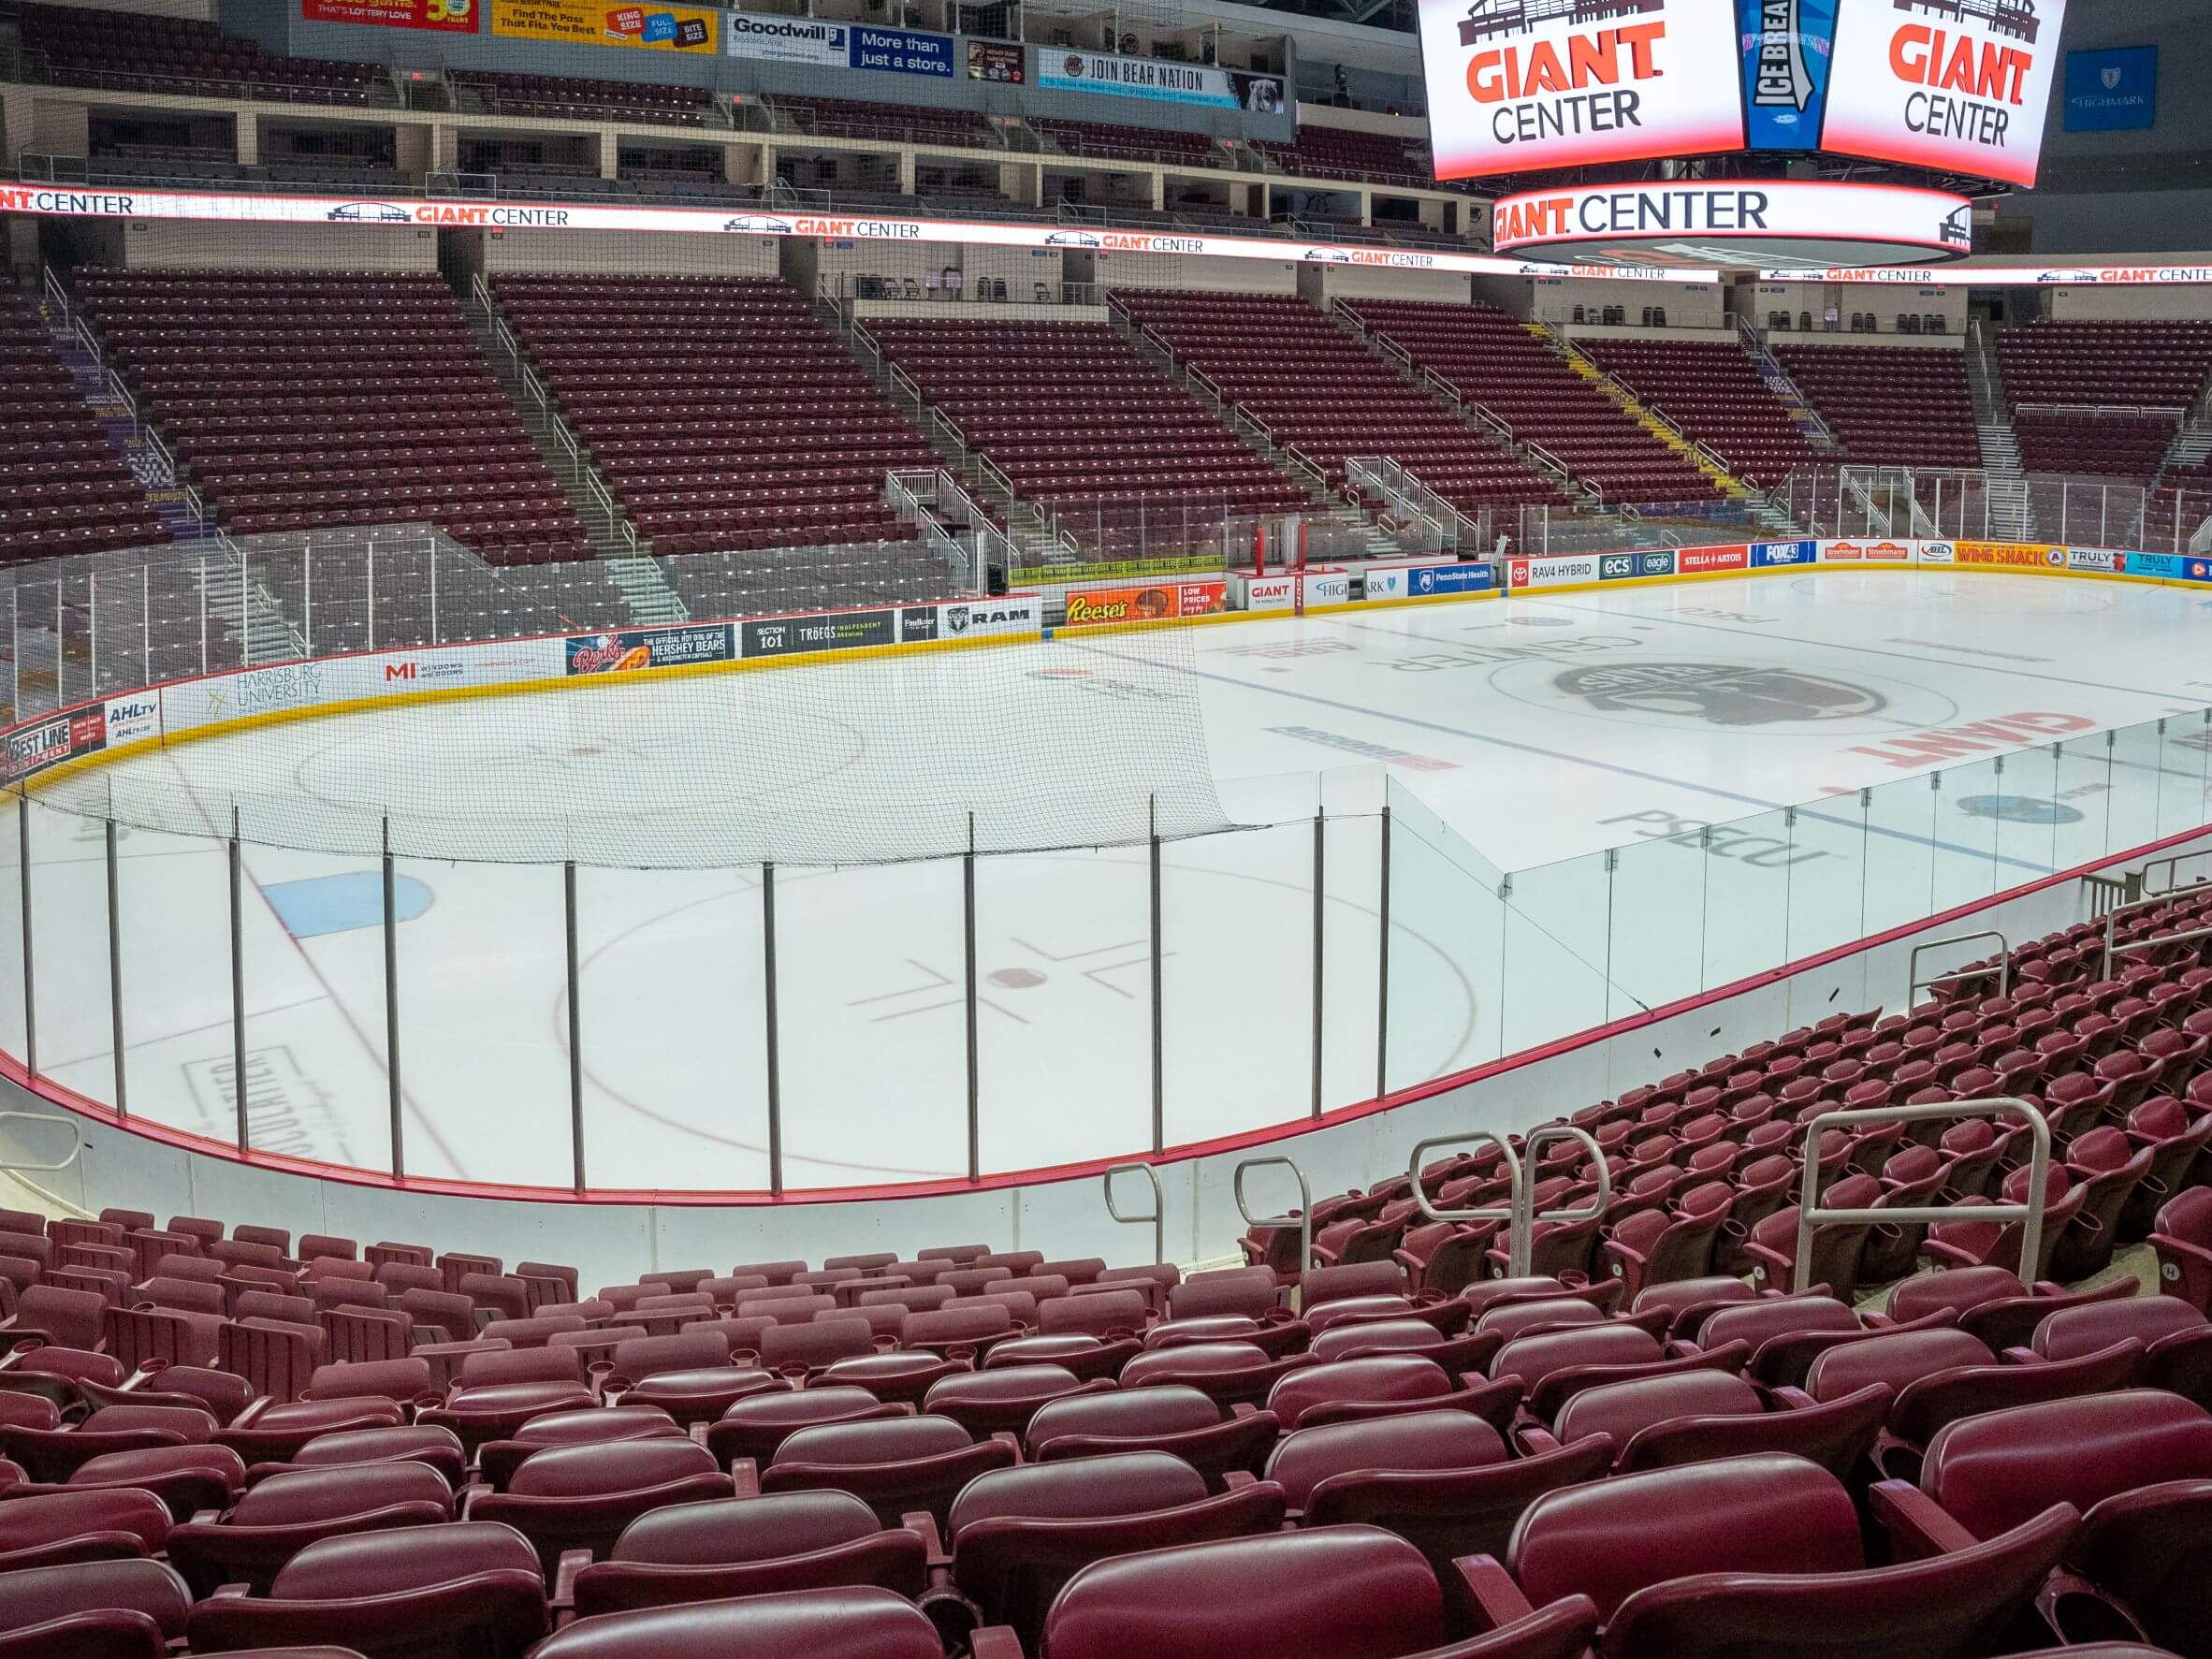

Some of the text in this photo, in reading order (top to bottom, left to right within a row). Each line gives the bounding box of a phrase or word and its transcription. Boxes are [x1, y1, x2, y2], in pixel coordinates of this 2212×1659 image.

[349, 7, 388, 18] LOTTERY
[389, 11, 413, 20] LOVE
[512, 8, 584, 23] Find The Pass
[617, 10, 641, 22] KING
[501, 17, 526, 28] That
[529, 20, 548, 30] Fits
[551, 22, 570, 32] You
[620, 20, 642, 30] SIZE
[651, 18, 673, 27] FULL
[684, 23, 702, 33] BITE
[734, 18, 825, 40] Goodwill
[655, 26, 674, 36] SIZE
[686, 32, 705, 41] SIZE
[862, 32, 939, 53] More than
[861, 50, 952, 72] just a store.
[1466, 21, 1666, 104] GIANT
[1889, 23, 2032, 106] GIANT
[1089, 58, 1118, 80] JOIN
[1123, 62, 1155, 86] BEAR
[1159, 66, 1203, 92] NATION
[2074, 95, 2145, 108] HIGHMARK
[1492, 89, 1642, 144] CENTER
[1905, 91, 2009, 147] CENTER
[37, 193, 133, 213] CENTER
[415, 206, 569, 226] GIANT CENTER
[1494, 191, 1768, 243] GIANT CENTER
[794, 220, 919, 239] GIANT CENTER
[1103, 235, 1203, 253] GIANT CENTER
[1351, 251, 1433, 268] GIANT CENTER
[1571, 264, 1665, 280] GIANT CENTER
[1826, 269, 1931, 283] GIANT CENTER
[2101, 269, 2158, 282] GIANT
[1826, 548, 1859, 557] Stroehmann
[1868, 548, 1906, 557] Stroehmann
[1928, 545, 1947, 554] AHL
[1957, 546, 2046, 566] WING SHACK
[2070, 551, 2111, 562] TRULY
[1646, 557, 1669, 571] eagle
[1685, 553, 1741, 565] STELLA ARTOIS
[2138, 554, 2173, 564] TRULY
[1468, 570, 1489, 578] Health
[1532, 563, 1592, 580] RAV4 HYBRID
[1605, 560, 1629, 574] ecs
[1252, 585, 1289, 598] GIANT
[1184, 595, 1210, 604] PRICES
[971, 609, 1029, 624] RAM
[1068, 596, 1128, 622] Reese's
[904, 618, 936, 628] Faulkner
[757, 626, 786, 636] SECTION
[652, 639, 725, 657] HERSHEY BEARS
[656, 636, 680, 645] OFFICIAL
[760, 635, 784, 649] 101
[1391, 635, 1643, 672] CENTER
[386, 662, 416, 682] MI
[421, 662, 463, 672] WINDOWS
[435, 668, 463, 677] DOORS
[238, 663, 322, 689] HARRISBURG
[238, 679, 321, 706] UNIVERSITY
[109, 703, 156, 723] AHLTV
[11, 724, 69, 762] BEST LINE
[1845, 712, 2096, 768] GIANT
[1594, 809, 1831, 867] PSECU
